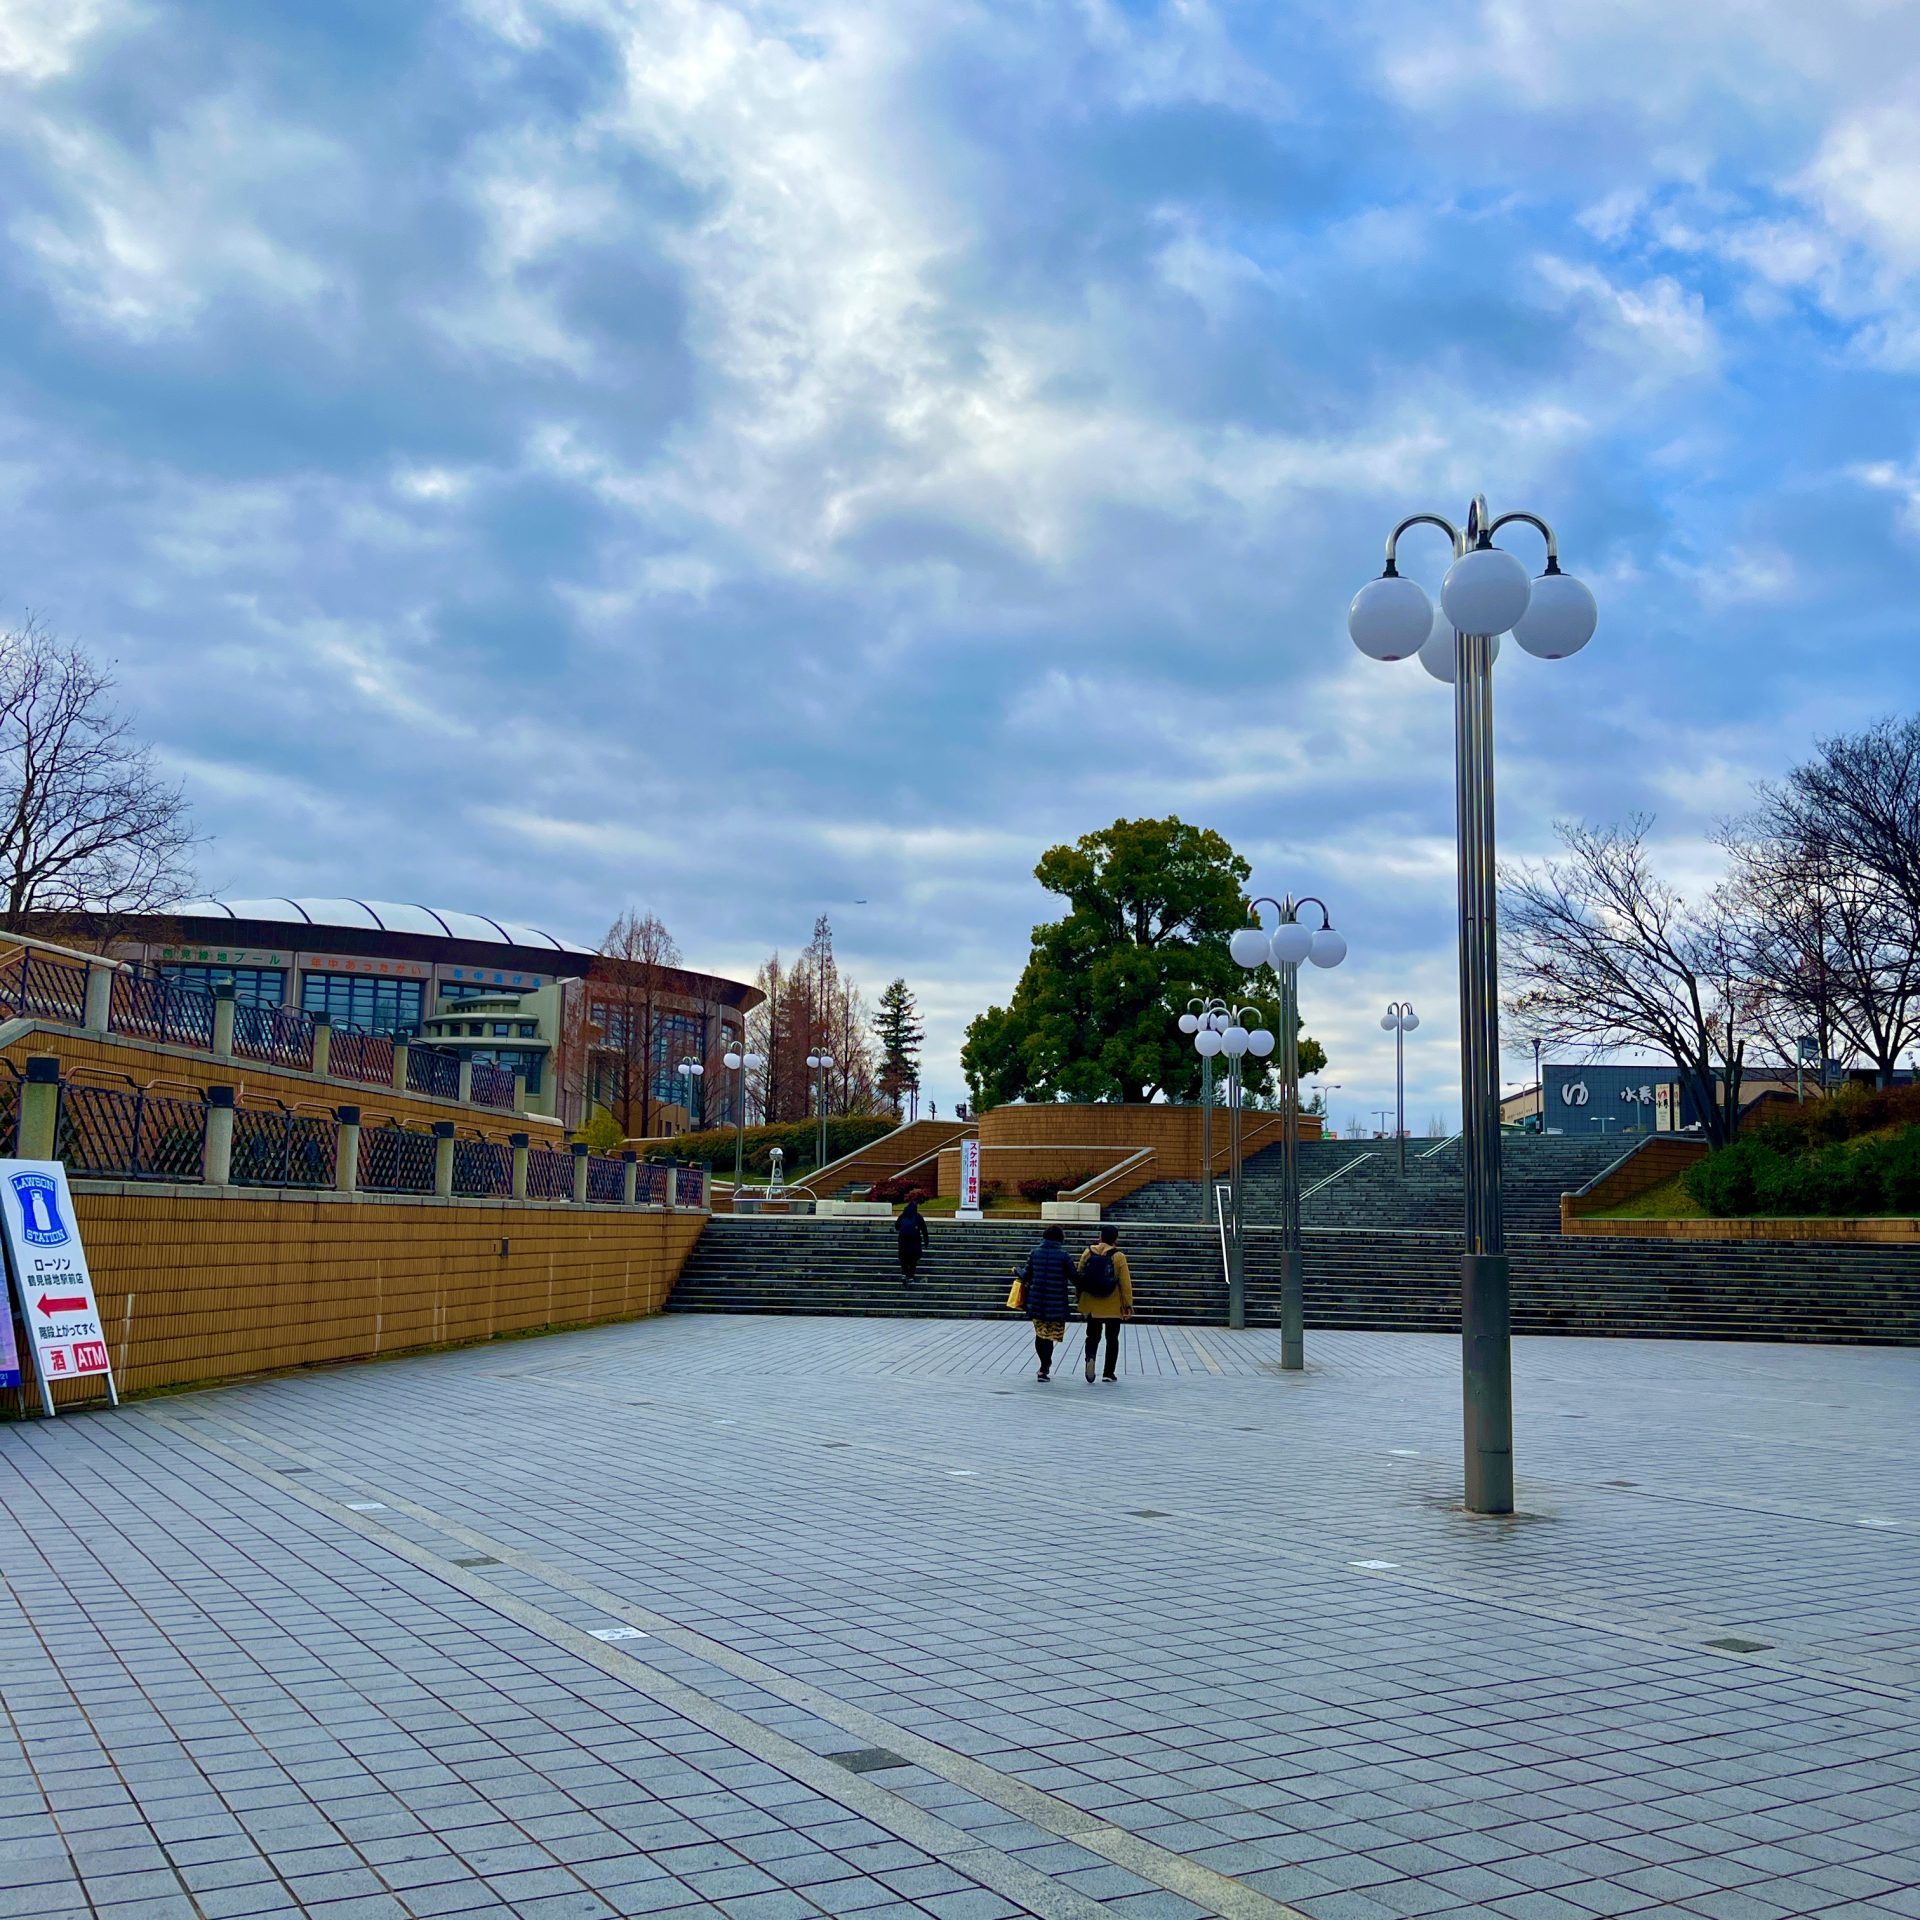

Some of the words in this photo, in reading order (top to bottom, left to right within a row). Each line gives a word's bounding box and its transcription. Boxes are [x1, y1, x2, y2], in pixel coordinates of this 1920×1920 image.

[1562, 1081, 1589, 1105] ゆ
[13, 1177, 55, 1192] LAWSON
[26, 1228, 66, 1243] STATION
[34, 1258, 71, 1272] ローソン
[27, 1273, 84, 1287] 鶴見緑地駅前店
[38, 1322, 96, 1340] 階段上がってすぐ
[50, 1350, 67, 1371] 酒
[77, 1345, 106, 1369] ATM
